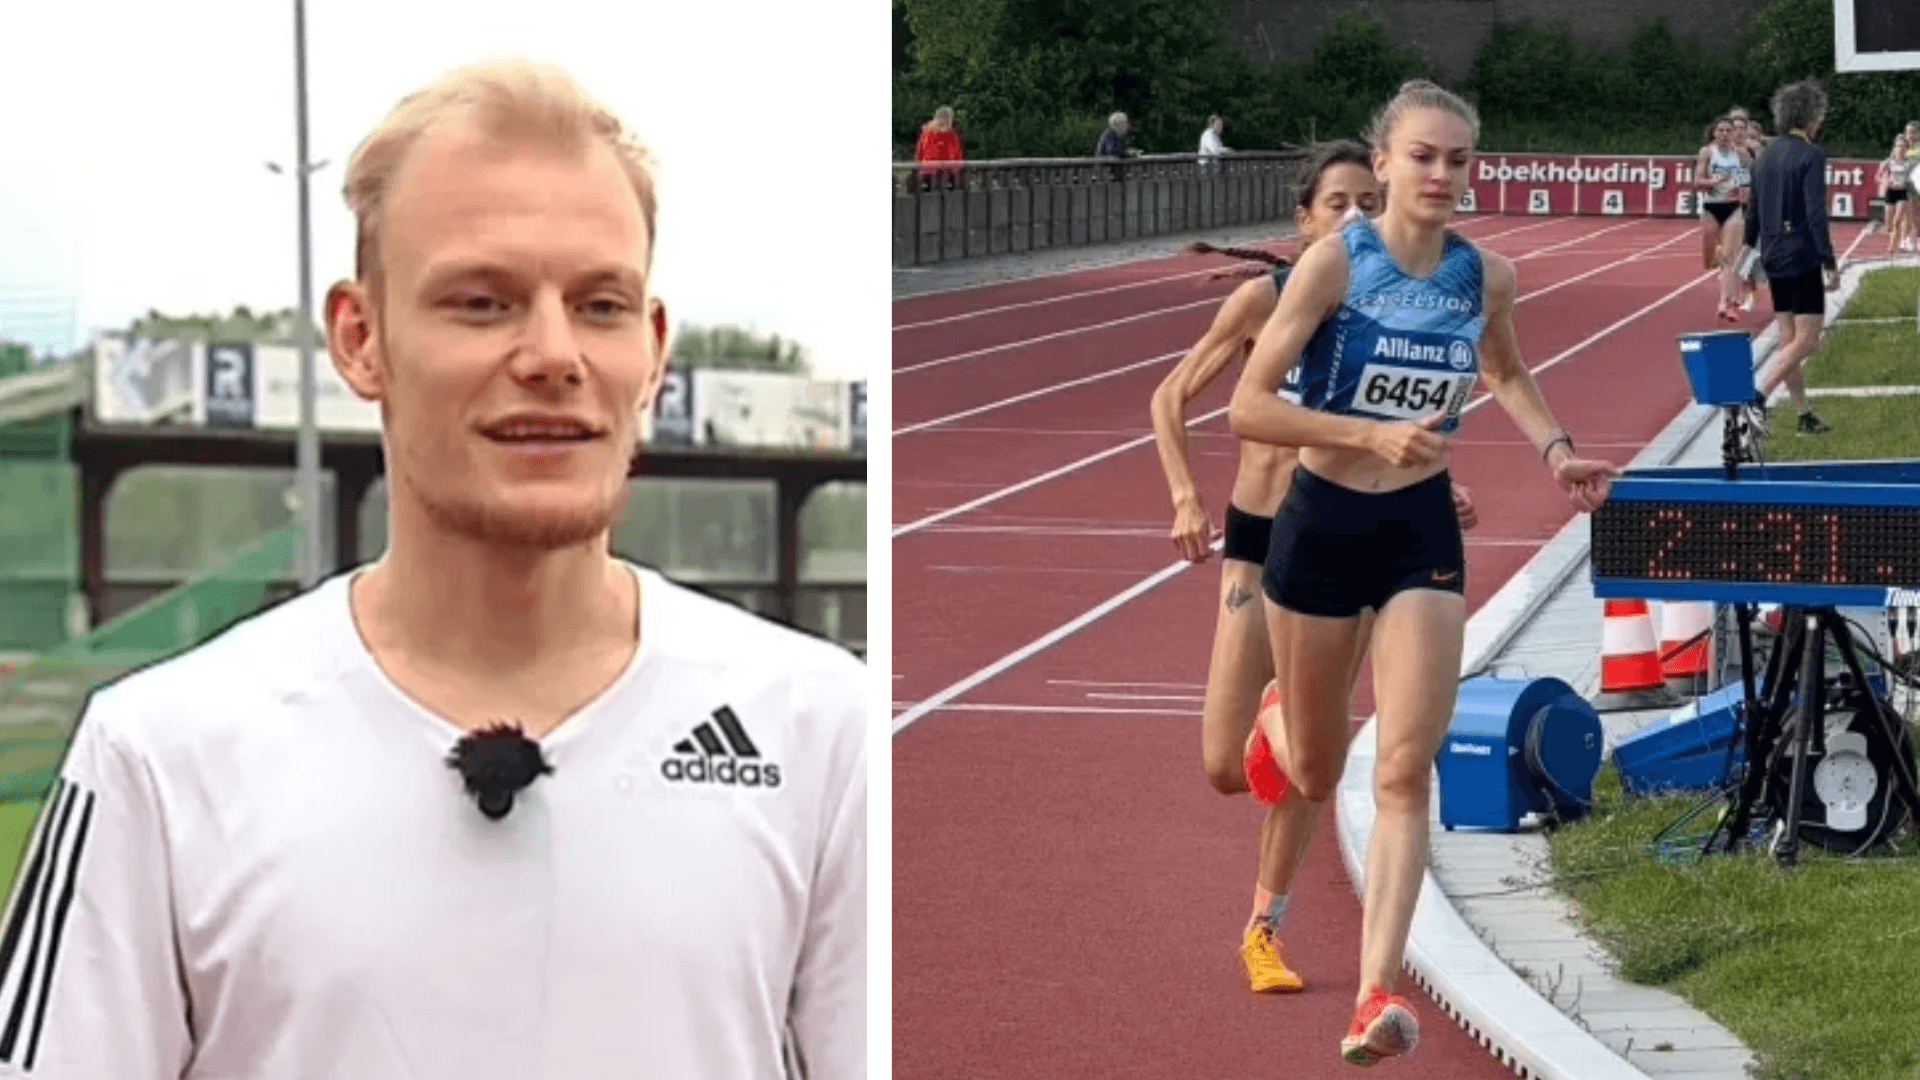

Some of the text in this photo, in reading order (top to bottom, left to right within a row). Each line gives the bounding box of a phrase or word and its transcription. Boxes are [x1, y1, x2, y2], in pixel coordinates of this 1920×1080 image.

[1478, 161, 1666, 189] boekhouding
[1533, 192, 1545, 209] 5
[1606, 194, 1619, 209] 4
[1837, 196, 1847, 212] 1
[1374, 336, 1446, 362] Allianz
[1365, 373, 1450, 411] 6454
[660, 754, 782, 788] adidas
